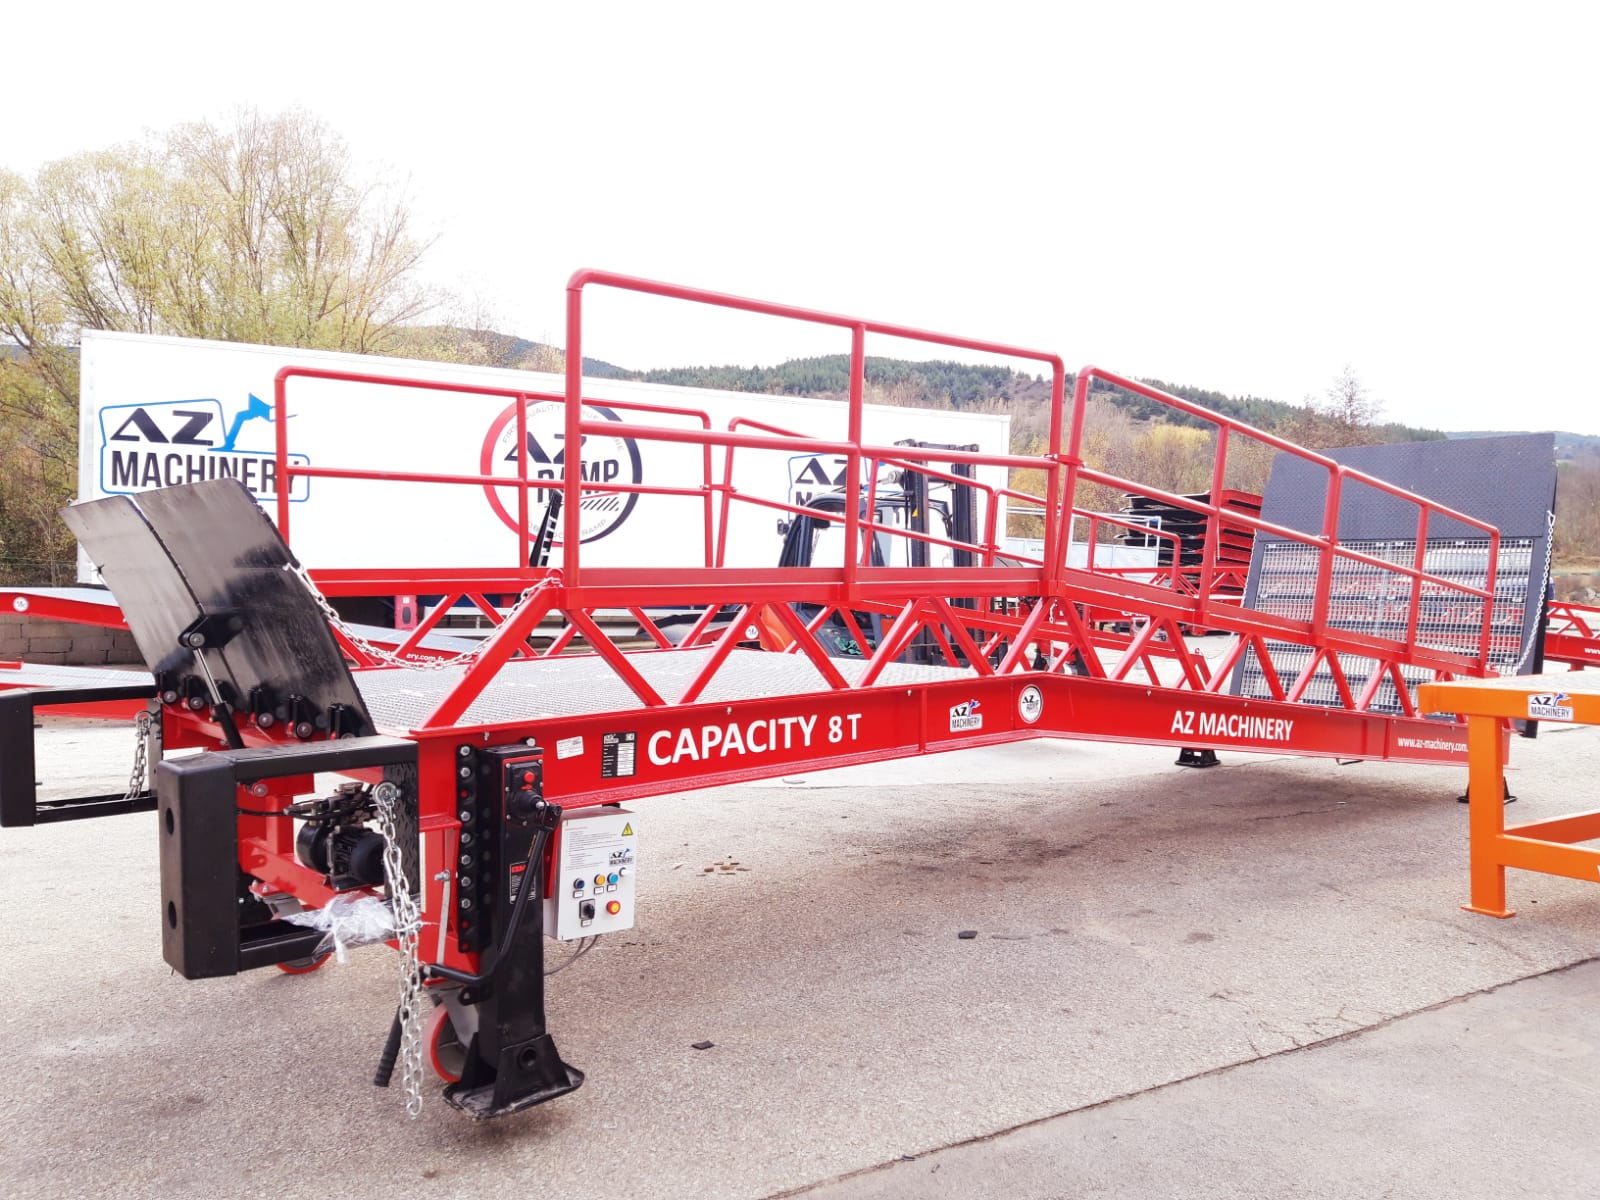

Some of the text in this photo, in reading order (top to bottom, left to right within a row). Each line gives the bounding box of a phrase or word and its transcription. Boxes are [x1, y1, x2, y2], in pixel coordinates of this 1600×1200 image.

[110, 407, 214, 447] AZ
[795, 457, 850, 488] AZ
[952, 706, 968, 718] AZ
[1531, 696, 1552, 706] AZ
[1531, 706, 1570, 718] MACHINERY
[647, 714, 818, 766] CAPACITY
[1171, 709, 1294, 741] AZ MACHINERY
